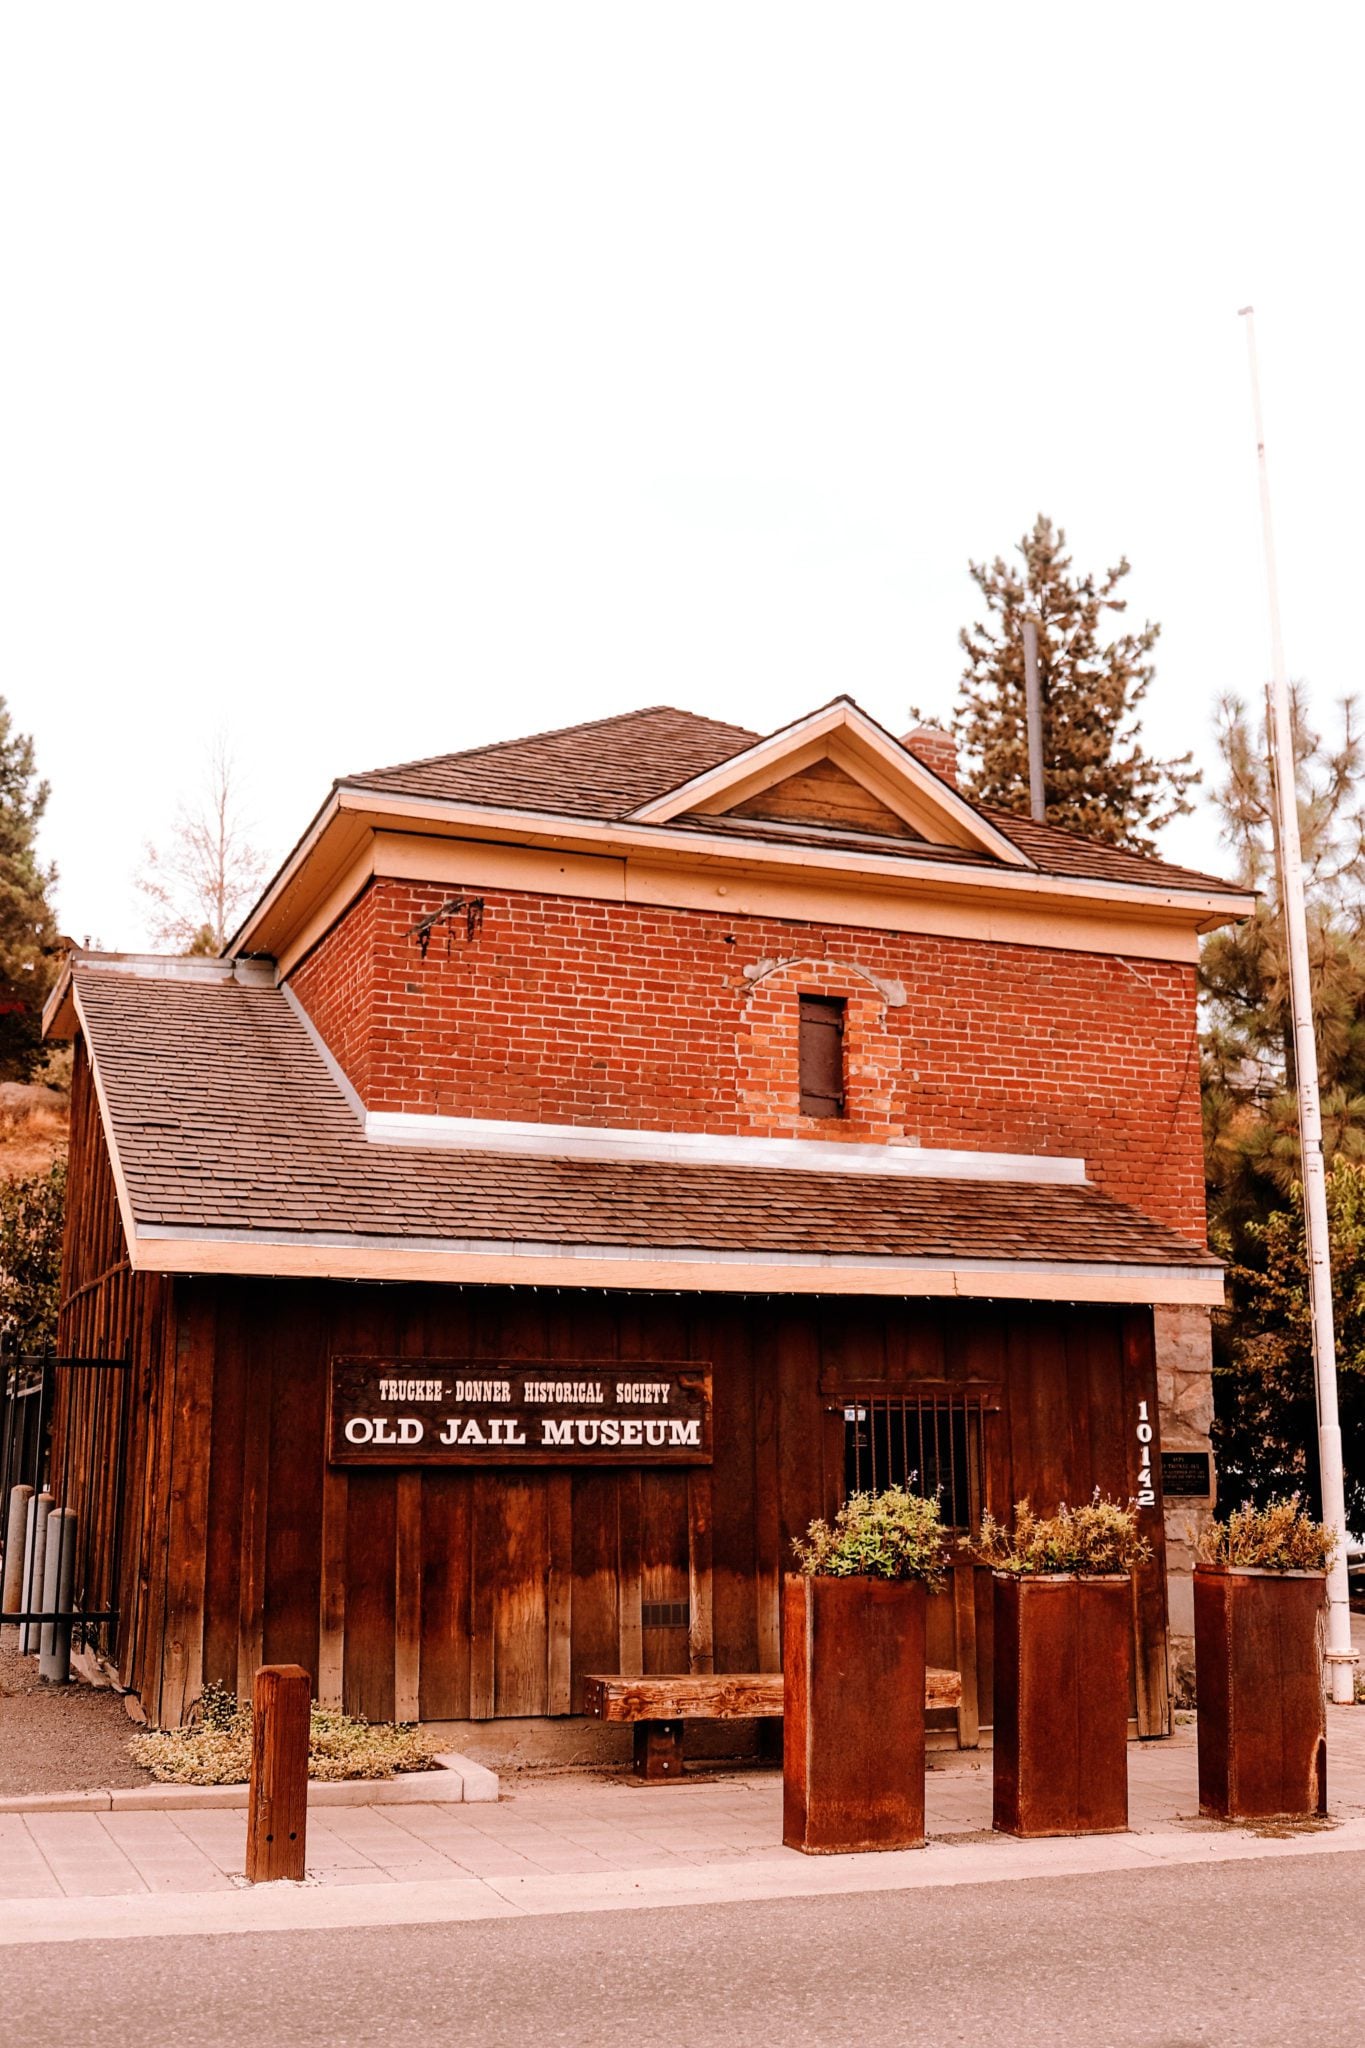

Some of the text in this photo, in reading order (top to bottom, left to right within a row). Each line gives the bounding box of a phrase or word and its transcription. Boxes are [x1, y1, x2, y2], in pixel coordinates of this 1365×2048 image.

[524, 1381, 604, 1404] HISTORICAL
[616, 1382, 671, 1404] SOCIETY
[344, 1417, 701, 1446] OLD JAIL MUSEUM
[1136, 1400, 1155, 1506] 10142
